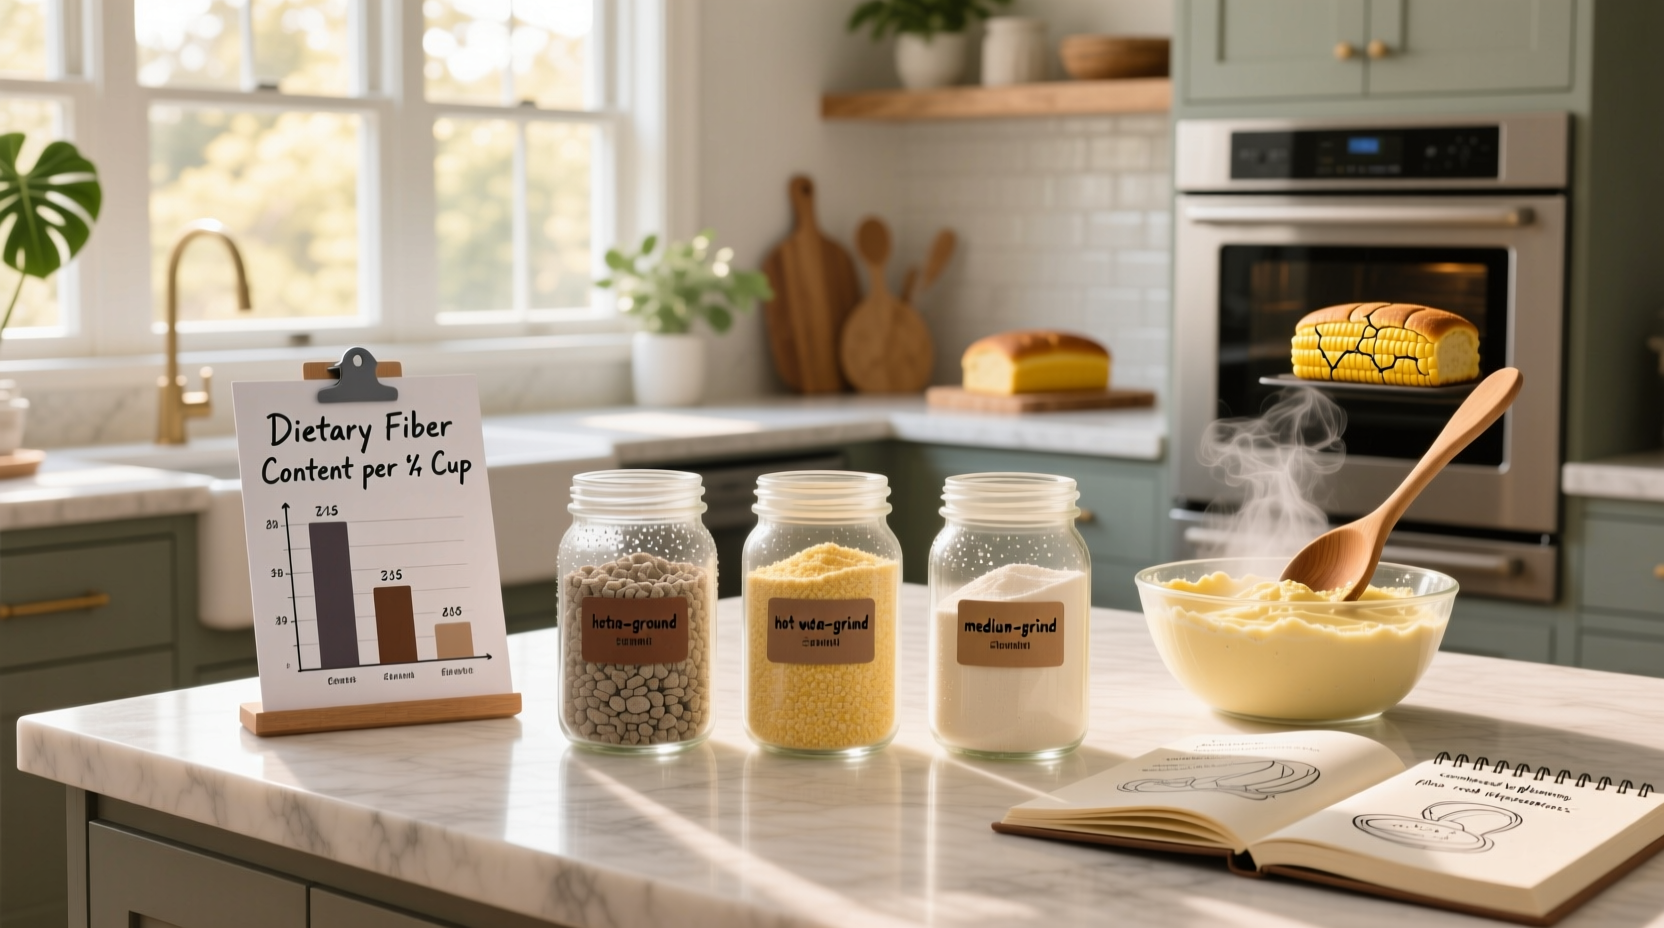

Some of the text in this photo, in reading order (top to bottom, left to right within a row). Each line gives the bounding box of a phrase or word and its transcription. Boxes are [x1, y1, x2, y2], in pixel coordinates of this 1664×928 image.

[266, 410, 453, 454] Dietary Fiber
[261, 456, 354, 485] Content
[362, 461, 398, 490] per
[431, 450, 472, 485] Cup
[775, 615, 794, 630] hot
